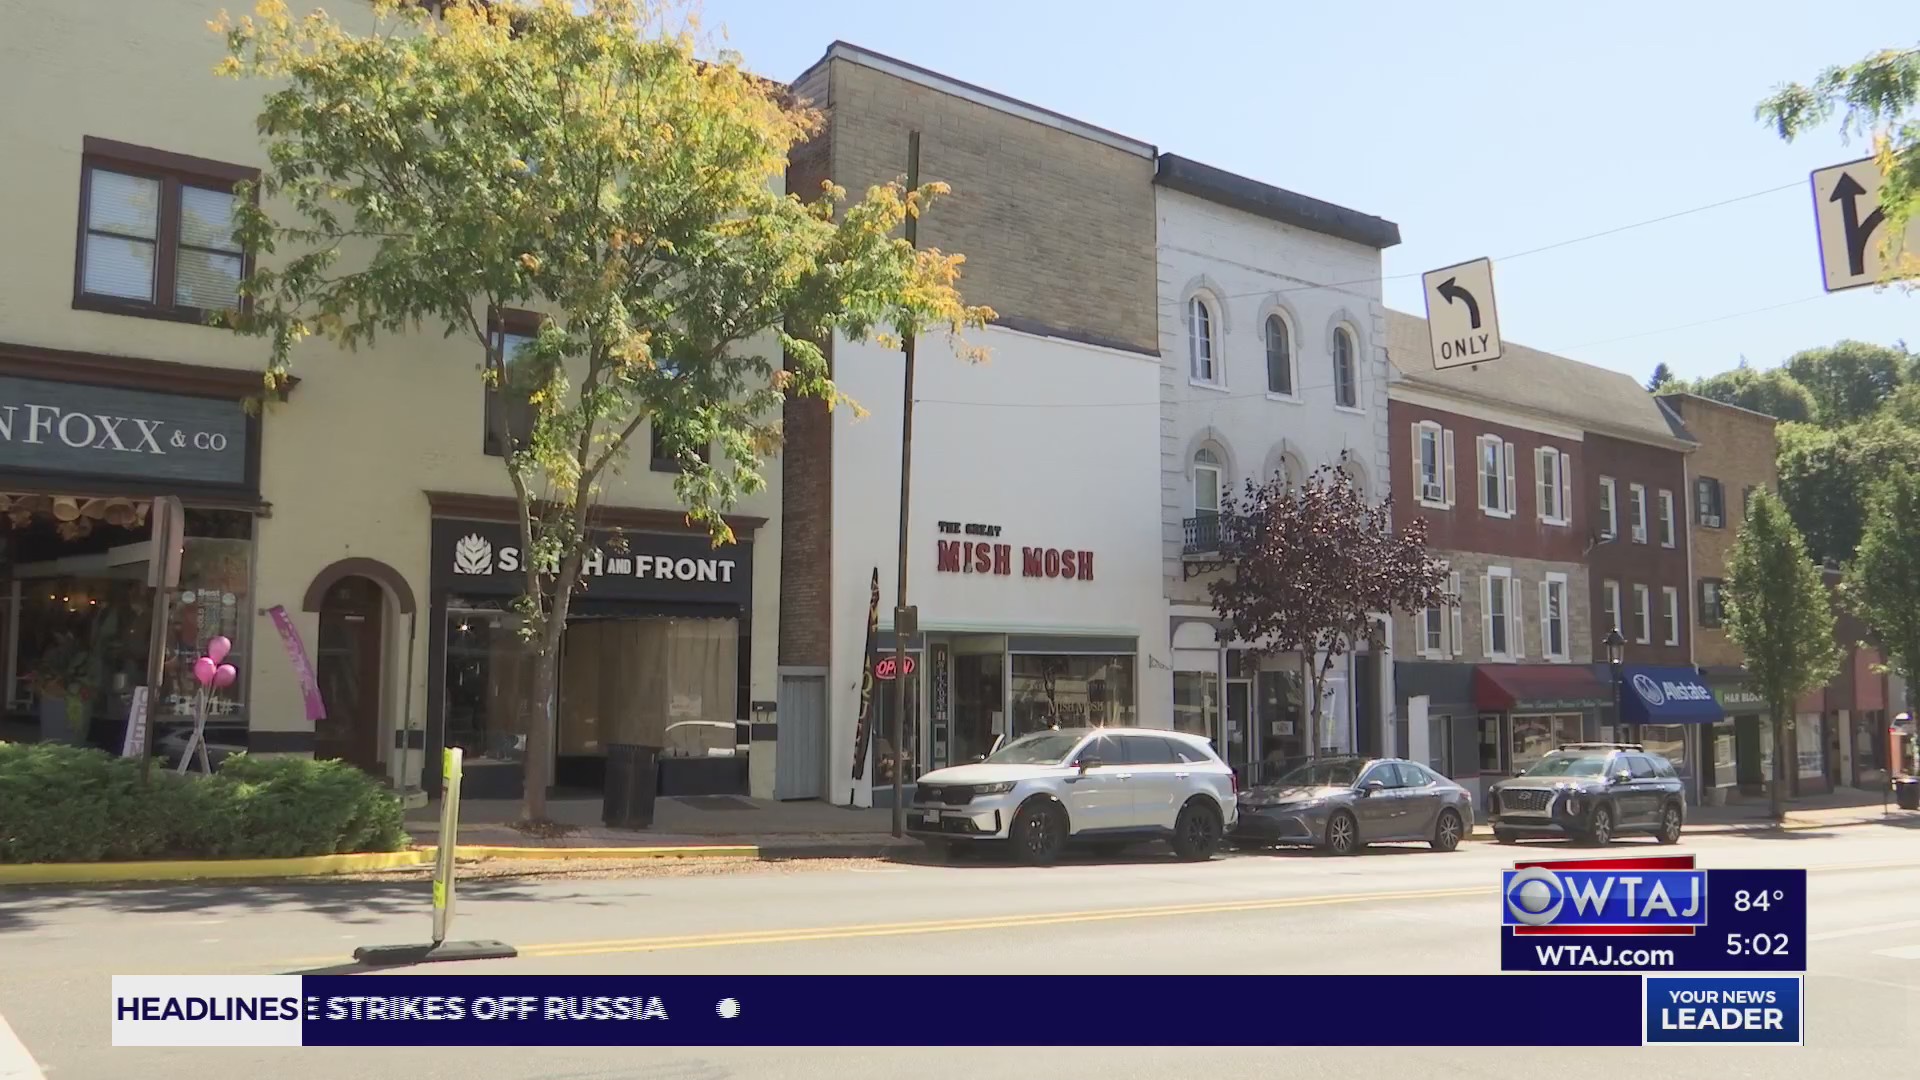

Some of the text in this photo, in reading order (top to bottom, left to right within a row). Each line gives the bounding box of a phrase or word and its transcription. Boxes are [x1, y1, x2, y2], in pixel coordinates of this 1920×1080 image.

[1441, 334, 1488, 360] ONLY
[170, 430, 186, 448] &
[194, 432, 228, 451] CO
[938, 521, 1002, 537] THE GREAT
[607, 558, 631, 575] AND
[636, 555, 736, 583] FRONT
[937, 540, 1094, 581] MISH MOSH
[878, 660, 910, 675] OPN
[1662, 681, 1711, 701] Allstate
[1724, 692, 1740, 703] H&R
